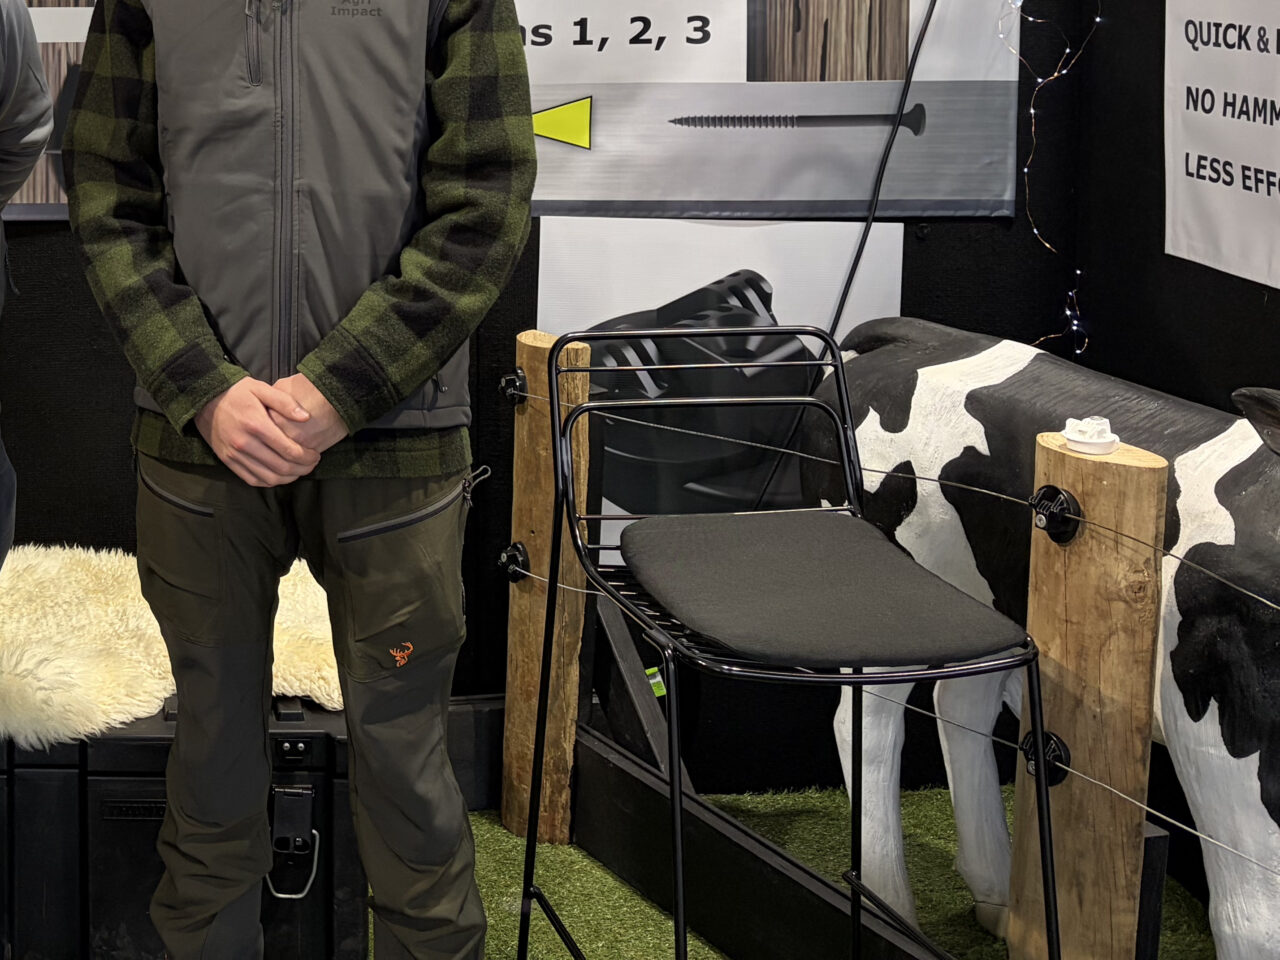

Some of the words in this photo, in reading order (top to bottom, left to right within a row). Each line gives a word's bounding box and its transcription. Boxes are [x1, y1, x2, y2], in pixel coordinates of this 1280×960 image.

[331, 6, 383, 18] Impact
[573, 17, 609, 52] 1,
[629, 16, 667, 52] 2,
[685, 15, 712, 45] 3
[1184, 19, 1251, 51] QUICK
[1257, 25, 1271, 54] &
[1186, 86, 1215, 114] NO
[1185, 152, 1234, 187] LESS
[1241, 165, 1280, 197] EFF
